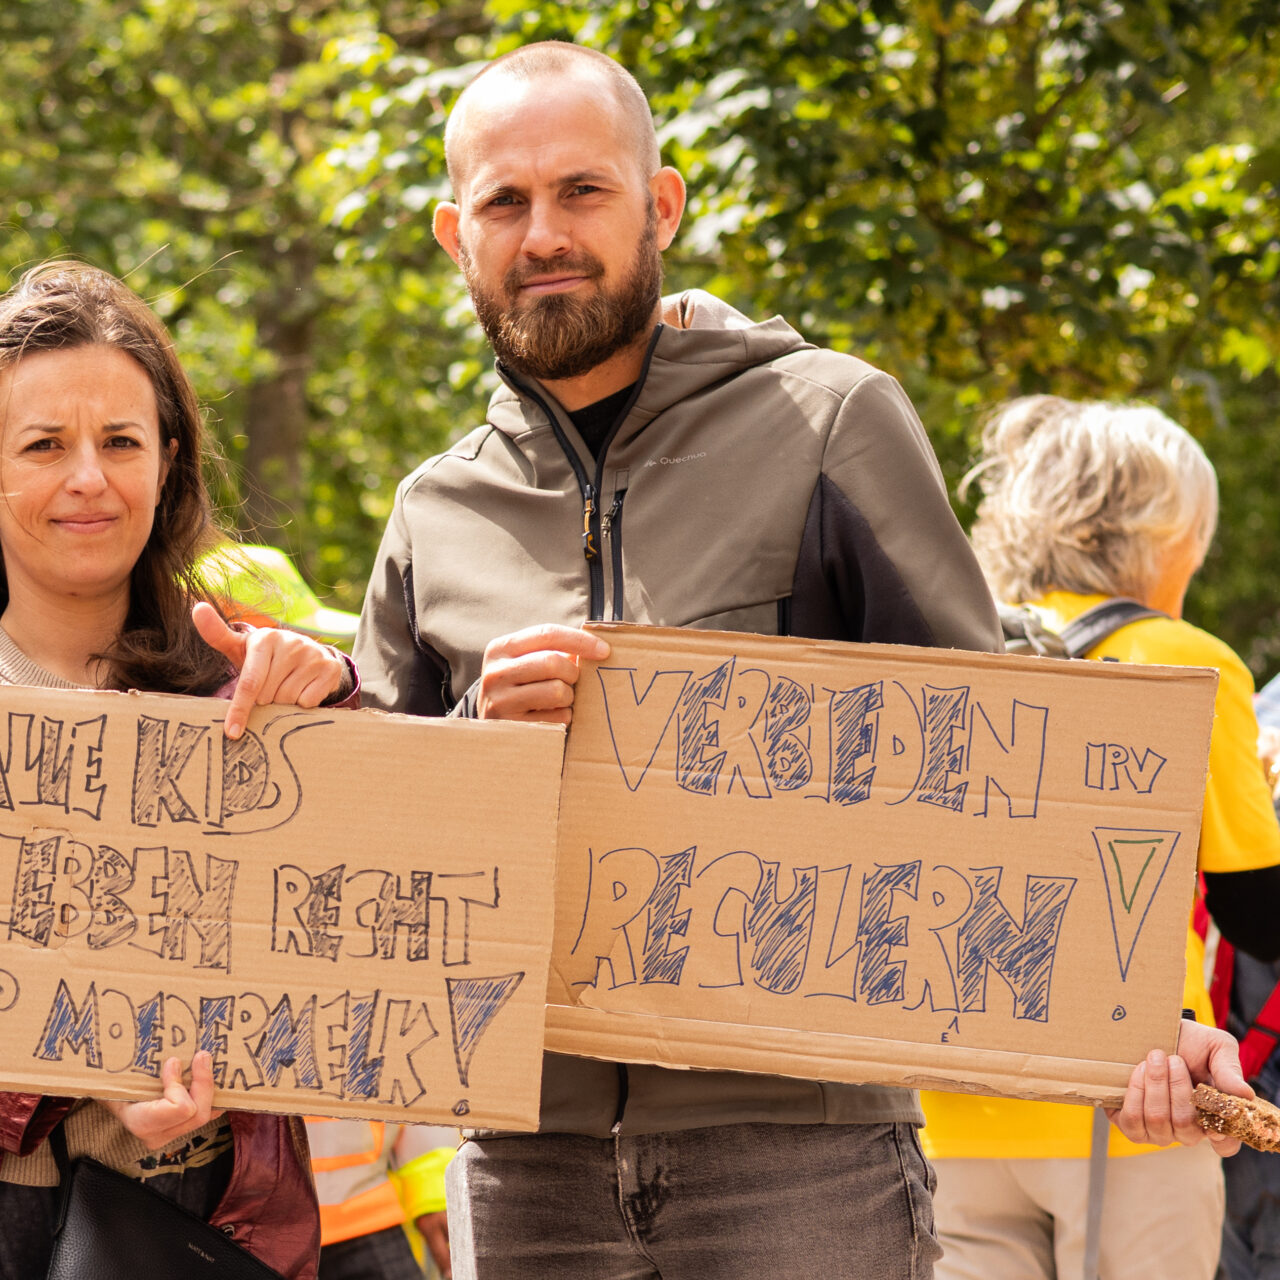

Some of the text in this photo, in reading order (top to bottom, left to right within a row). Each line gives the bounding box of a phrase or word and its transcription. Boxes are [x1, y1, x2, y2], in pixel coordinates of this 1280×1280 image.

[131, 712, 335, 836] KIDS
[598, 655, 1049, 818] VERBIEDEN
[271, 863, 500, 966] RECHT
